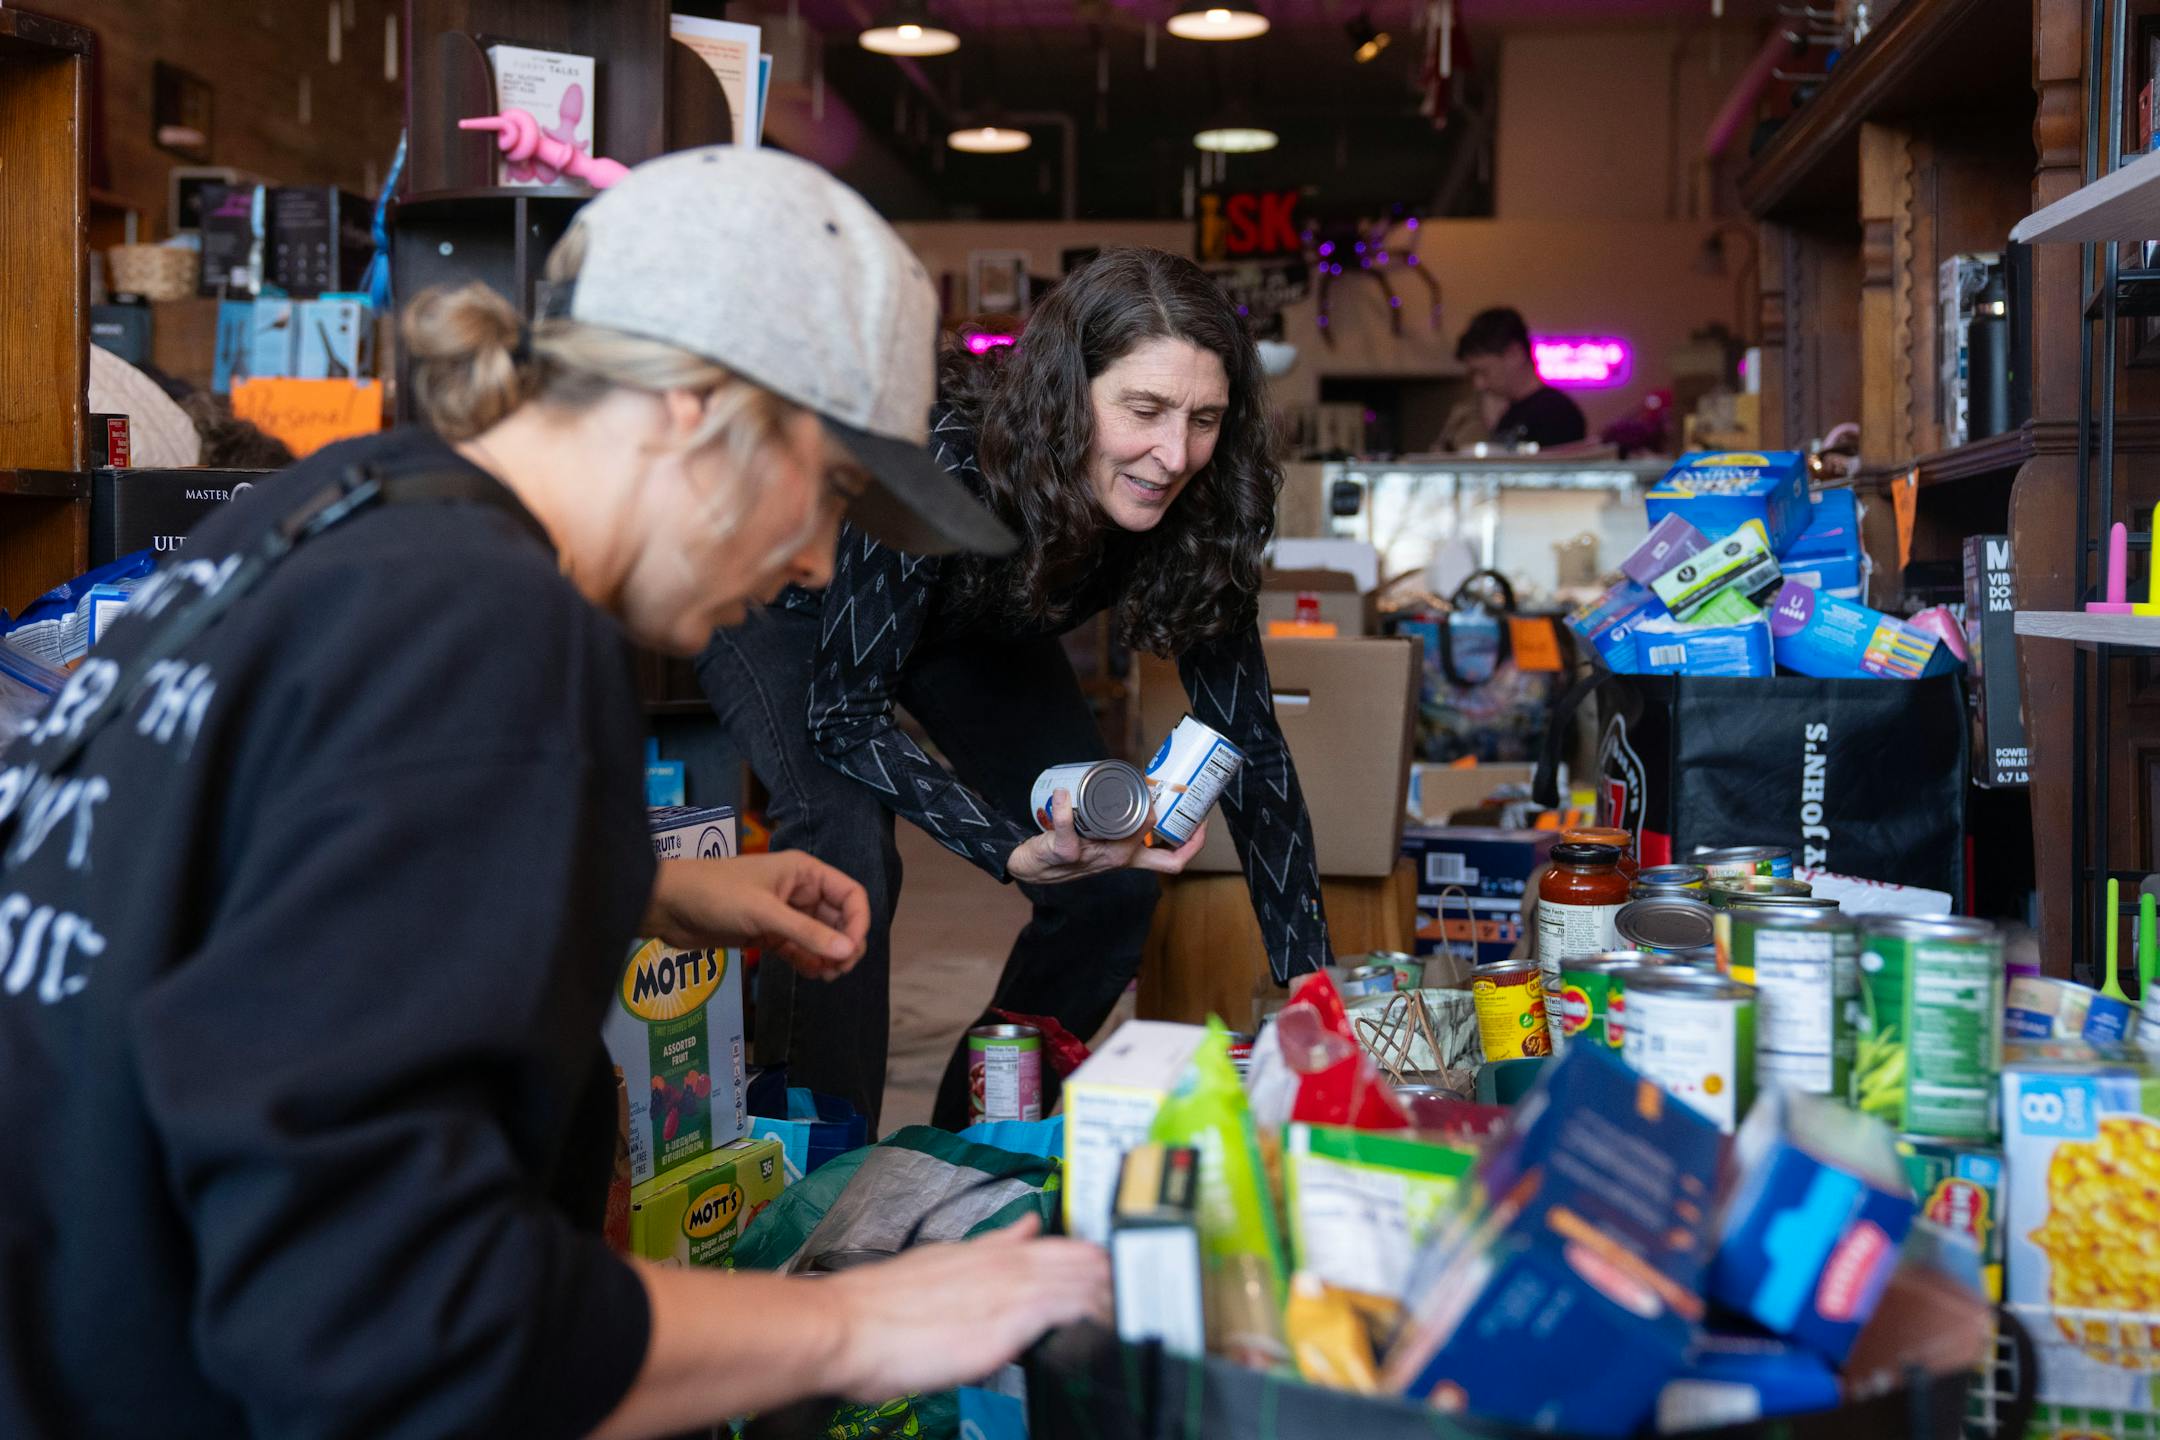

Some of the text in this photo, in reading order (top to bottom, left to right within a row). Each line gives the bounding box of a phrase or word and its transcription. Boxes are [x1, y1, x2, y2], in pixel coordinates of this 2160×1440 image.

[185, 488, 231, 501] MASTER
[1800, 722, 1831, 840] JOHN'S
[632, 946, 718, 1004] MOTT'S
[663, 1035, 697, 1057] ASSORTED
[671, 1052, 689, 1066] FRUIT
[762, 1160, 773, 1176] 36
[689, 1189, 737, 1231] MOTT'S
[701, 1237, 718, 1251] Sugar
[719, 1226, 737, 1241] Added
